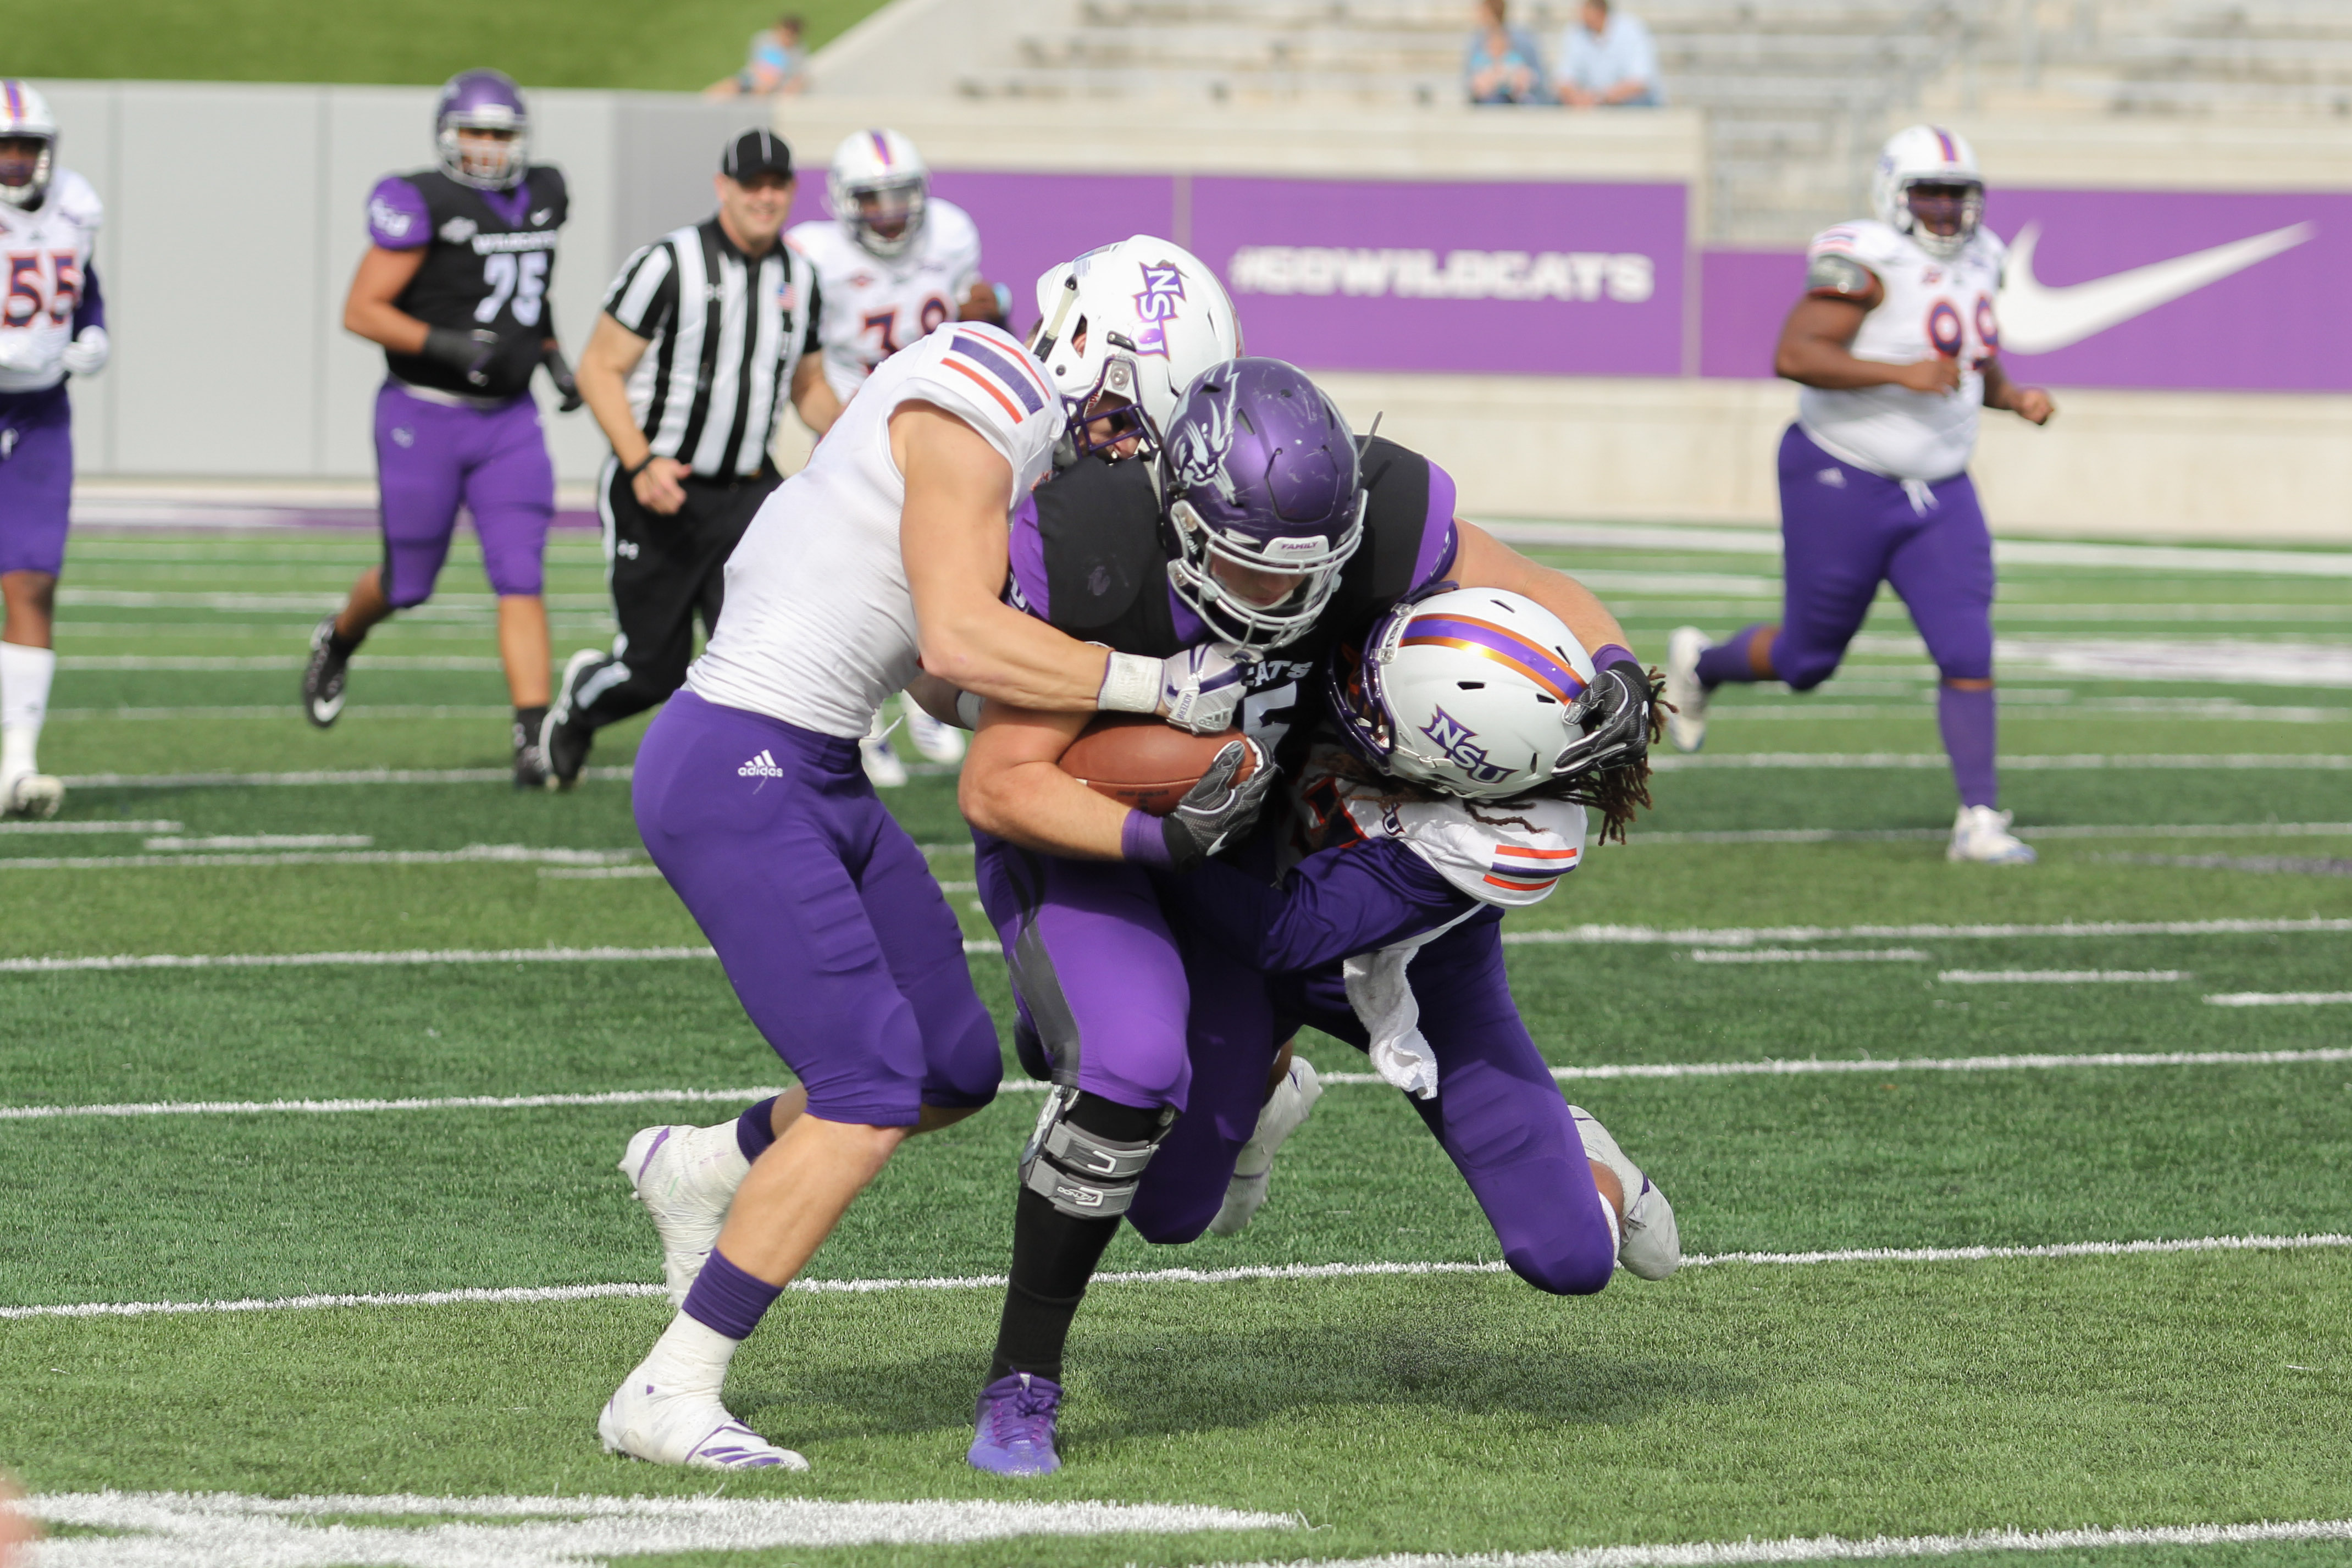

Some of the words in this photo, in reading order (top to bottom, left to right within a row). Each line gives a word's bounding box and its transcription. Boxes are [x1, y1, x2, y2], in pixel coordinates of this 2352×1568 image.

[4, 254, 85, 328] 55
[474, 251, 548, 326] 75
[1133, 268, 1181, 352] NSU
[738, 765, 783, 778] adidas
[1428, 714, 1508, 783] NSU
